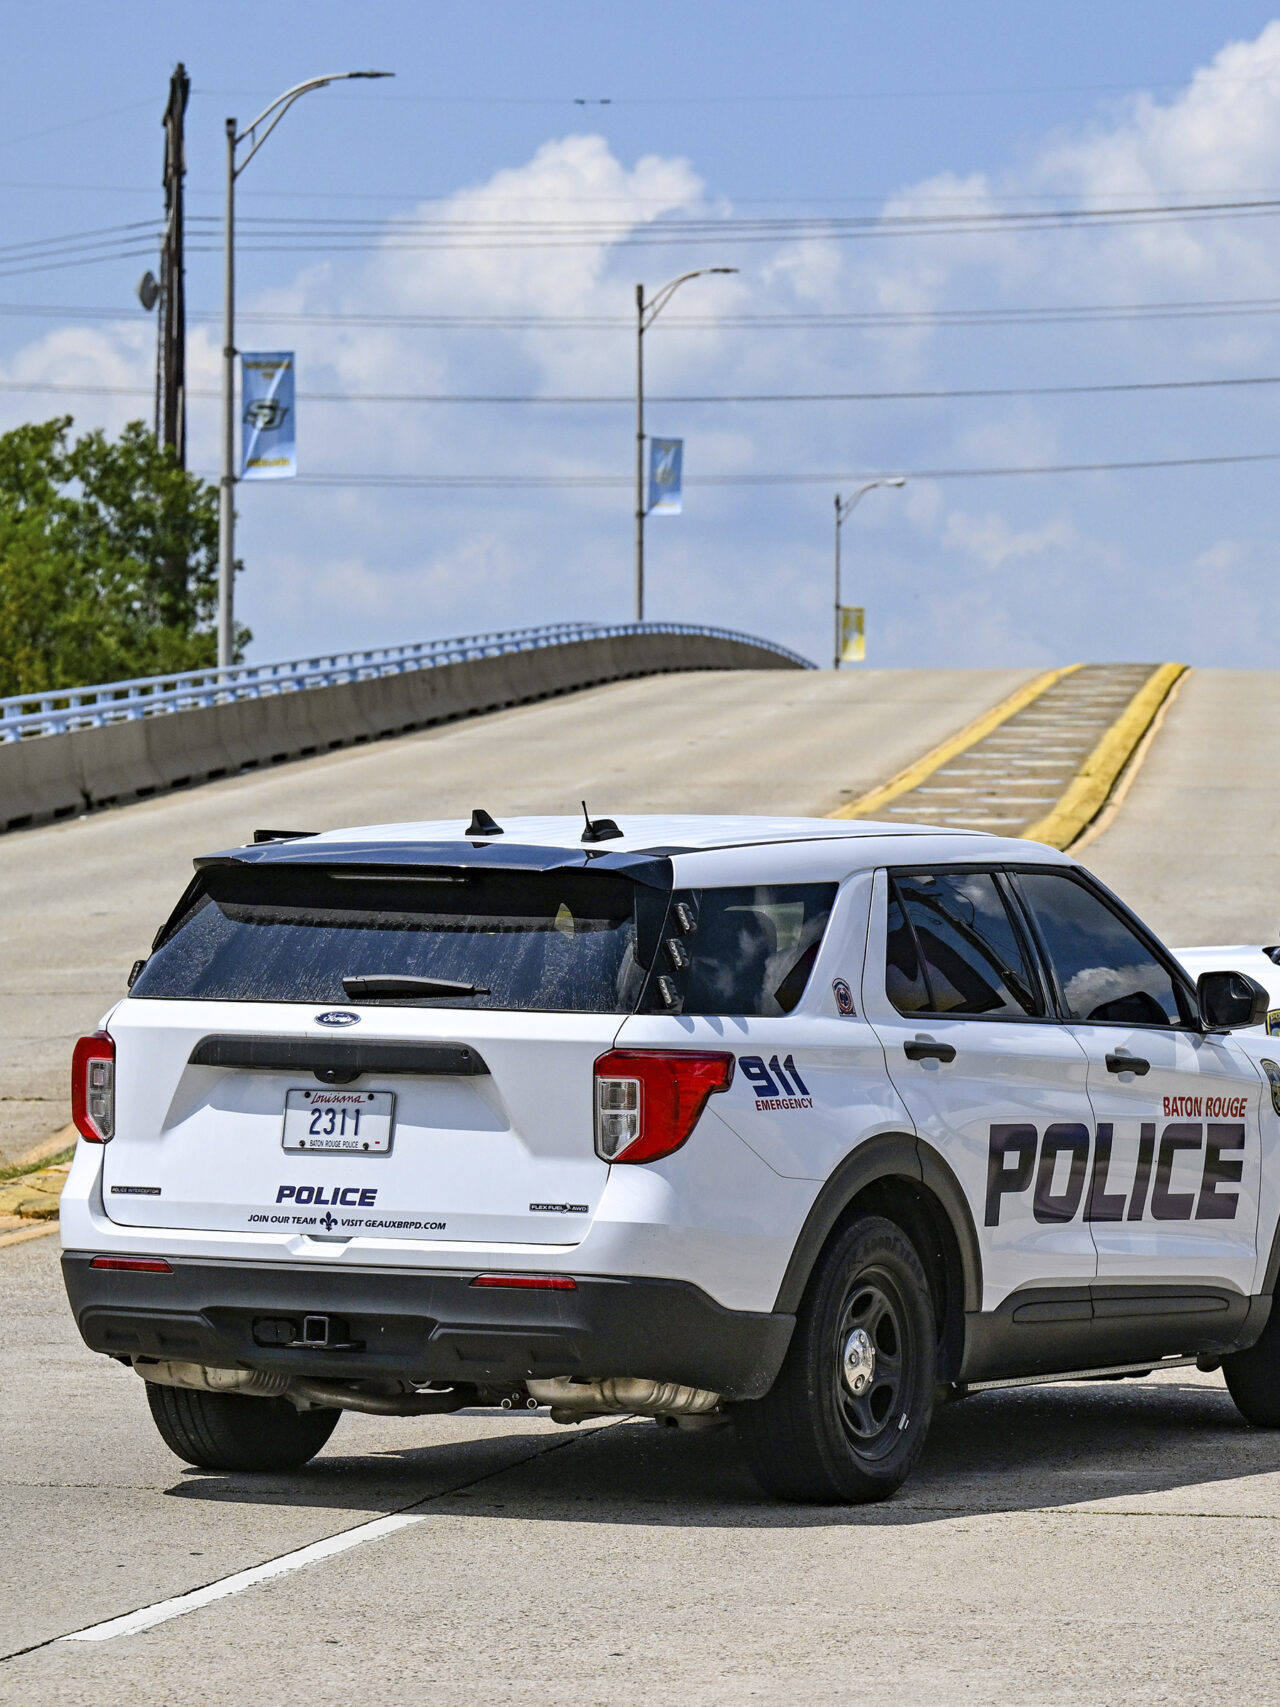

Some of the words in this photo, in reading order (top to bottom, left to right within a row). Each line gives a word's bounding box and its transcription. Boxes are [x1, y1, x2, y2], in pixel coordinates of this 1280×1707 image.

[738, 1054, 810, 1097] 911
[310, 1092, 366, 1104] Louisiana
[755, 1098, 813, 1111] EMERGENCY
[1163, 1096, 1203, 1117] BATON
[1205, 1097, 1248, 1117] ROUGE
[309, 1108, 360, 1136] 2311
[325, 1140, 341, 1148] ROUGE
[342, 1141, 359, 1149] POLICE
[984, 1123, 1246, 1227] POLICE
[275, 1185, 378, 1207] POLICE
[248, 1214, 269, 1223] JOIN
[270, 1215, 290, 1224] OUR
[291, 1216, 317, 1225] TEAM
[341, 1218, 364, 1227] VISIT
[365, 1220, 446, 1231] GEAUXBRPD.COM
